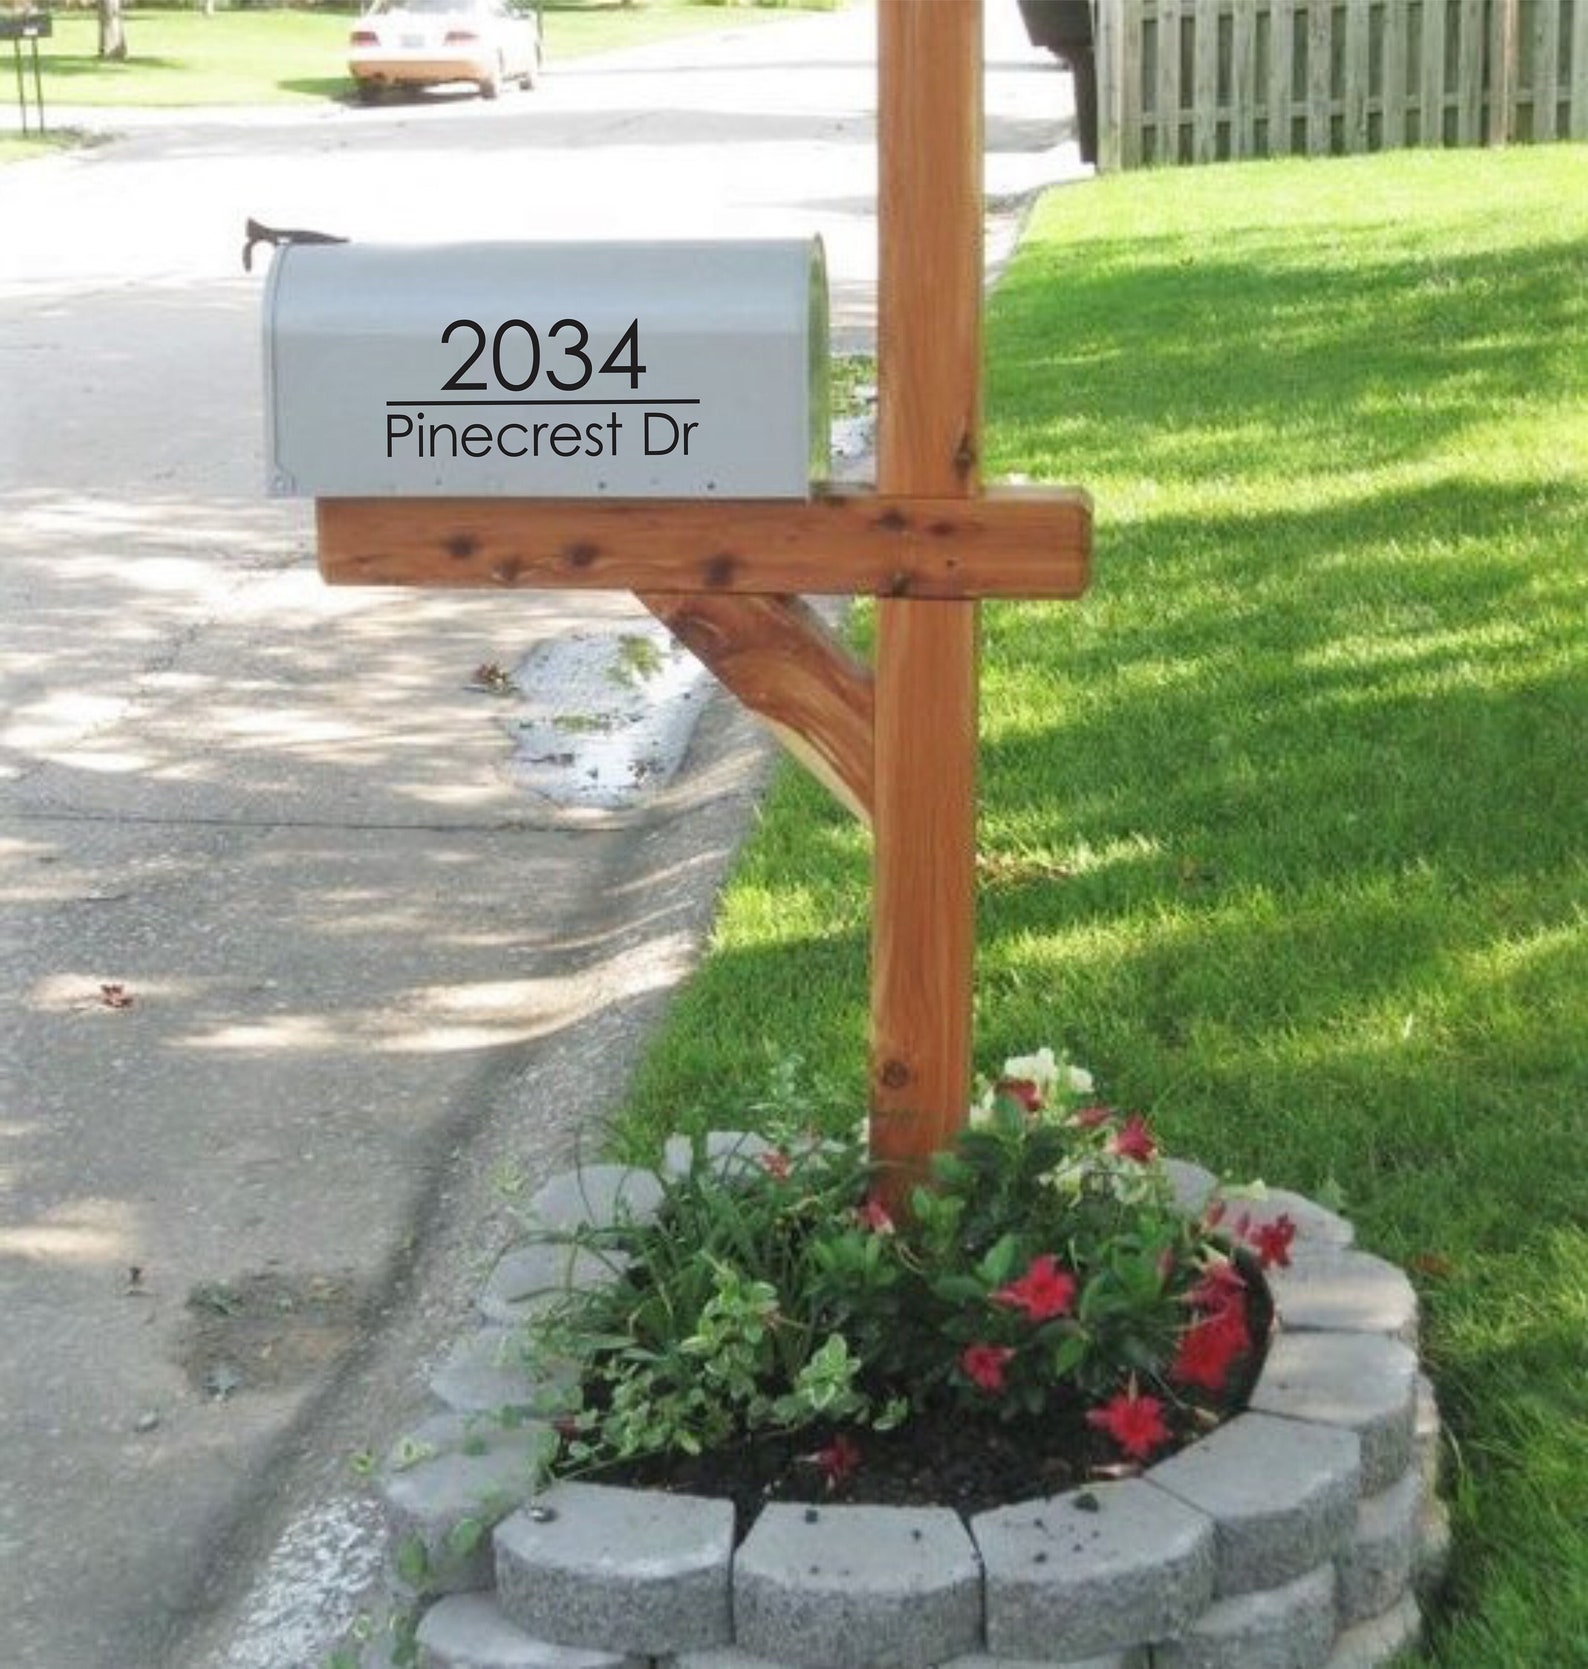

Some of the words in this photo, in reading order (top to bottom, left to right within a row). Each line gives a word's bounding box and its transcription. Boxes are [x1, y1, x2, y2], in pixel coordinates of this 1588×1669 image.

[441, 318, 647, 391] 2034
[386, 412, 623, 458] Pinecrest
[644, 412, 699, 456] Dr
